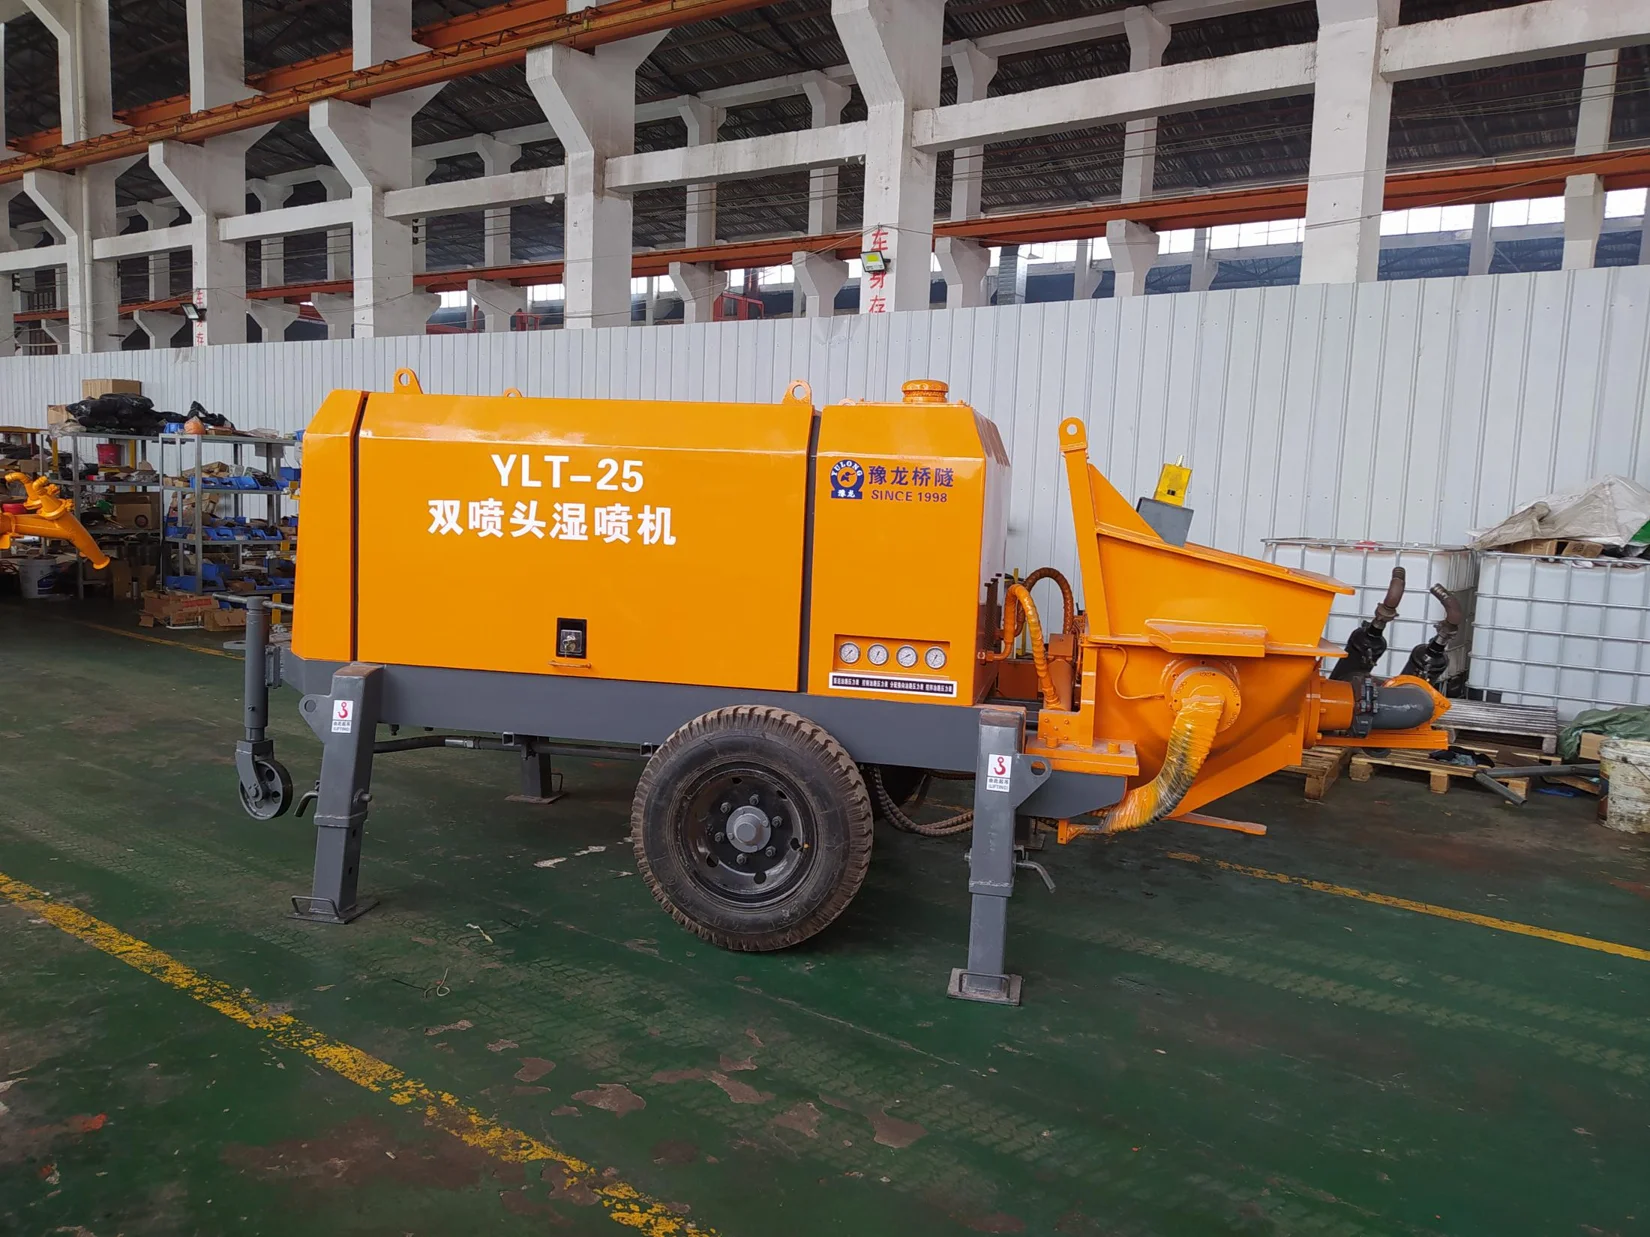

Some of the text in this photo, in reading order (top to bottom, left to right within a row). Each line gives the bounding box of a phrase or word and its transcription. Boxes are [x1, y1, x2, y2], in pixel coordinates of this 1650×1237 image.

[491, 453, 644, 492] YLT-25
[831, 460, 863, 476] YULONG
[868, 465, 954, 488] 豫龙桥隧
[871, 489, 948, 503] SINCE 1998
[427, 497, 677, 546] 双喷头湿喷机
